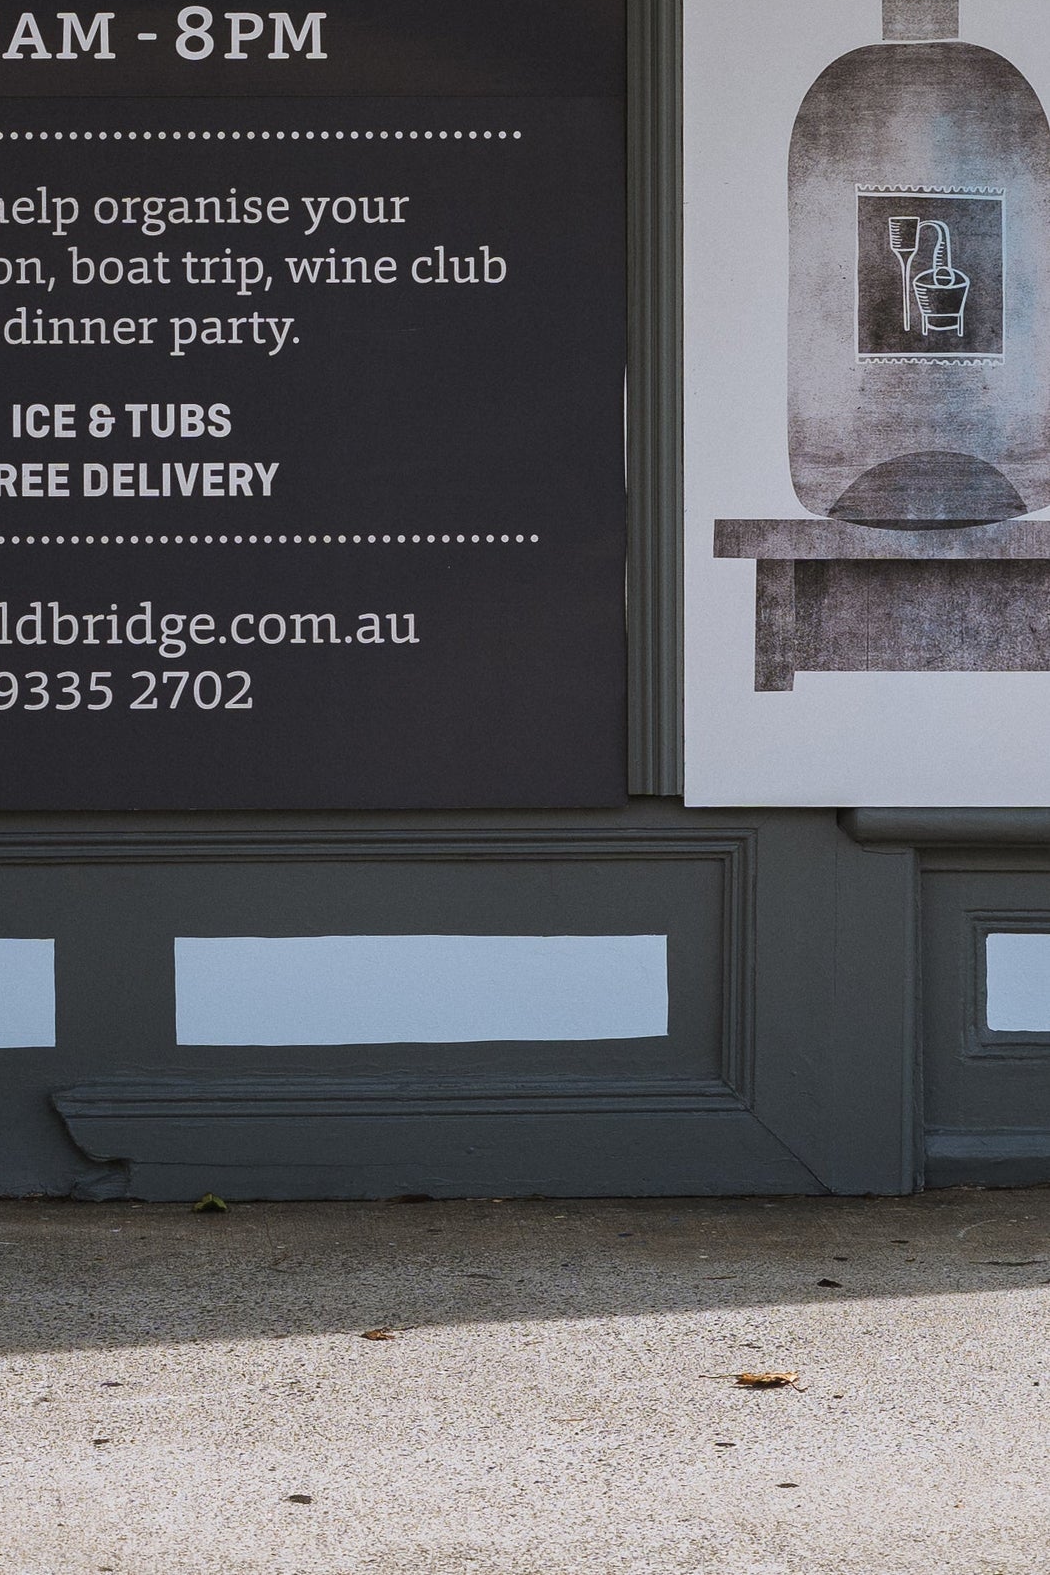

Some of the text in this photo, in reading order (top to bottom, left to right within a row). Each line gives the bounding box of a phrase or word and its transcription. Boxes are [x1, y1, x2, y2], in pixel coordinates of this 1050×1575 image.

[176, 6, 327, 60] 8PM
[94, 188, 289, 236] organise
[301, 197, 409, 235] your
[68, 246, 171, 284] boat
[182, 248, 272, 295] trip,
[285, 248, 397, 283] wine
[412, 245, 506, 283] club
[4, 307, 158, 344] dinner
[170, 312, 299, 356] party.
[13, 403, 231, 438] ICE & TUBS
[83, 463, 279, 496] DELIVERY
[130, 671, 252, 710] 2702
